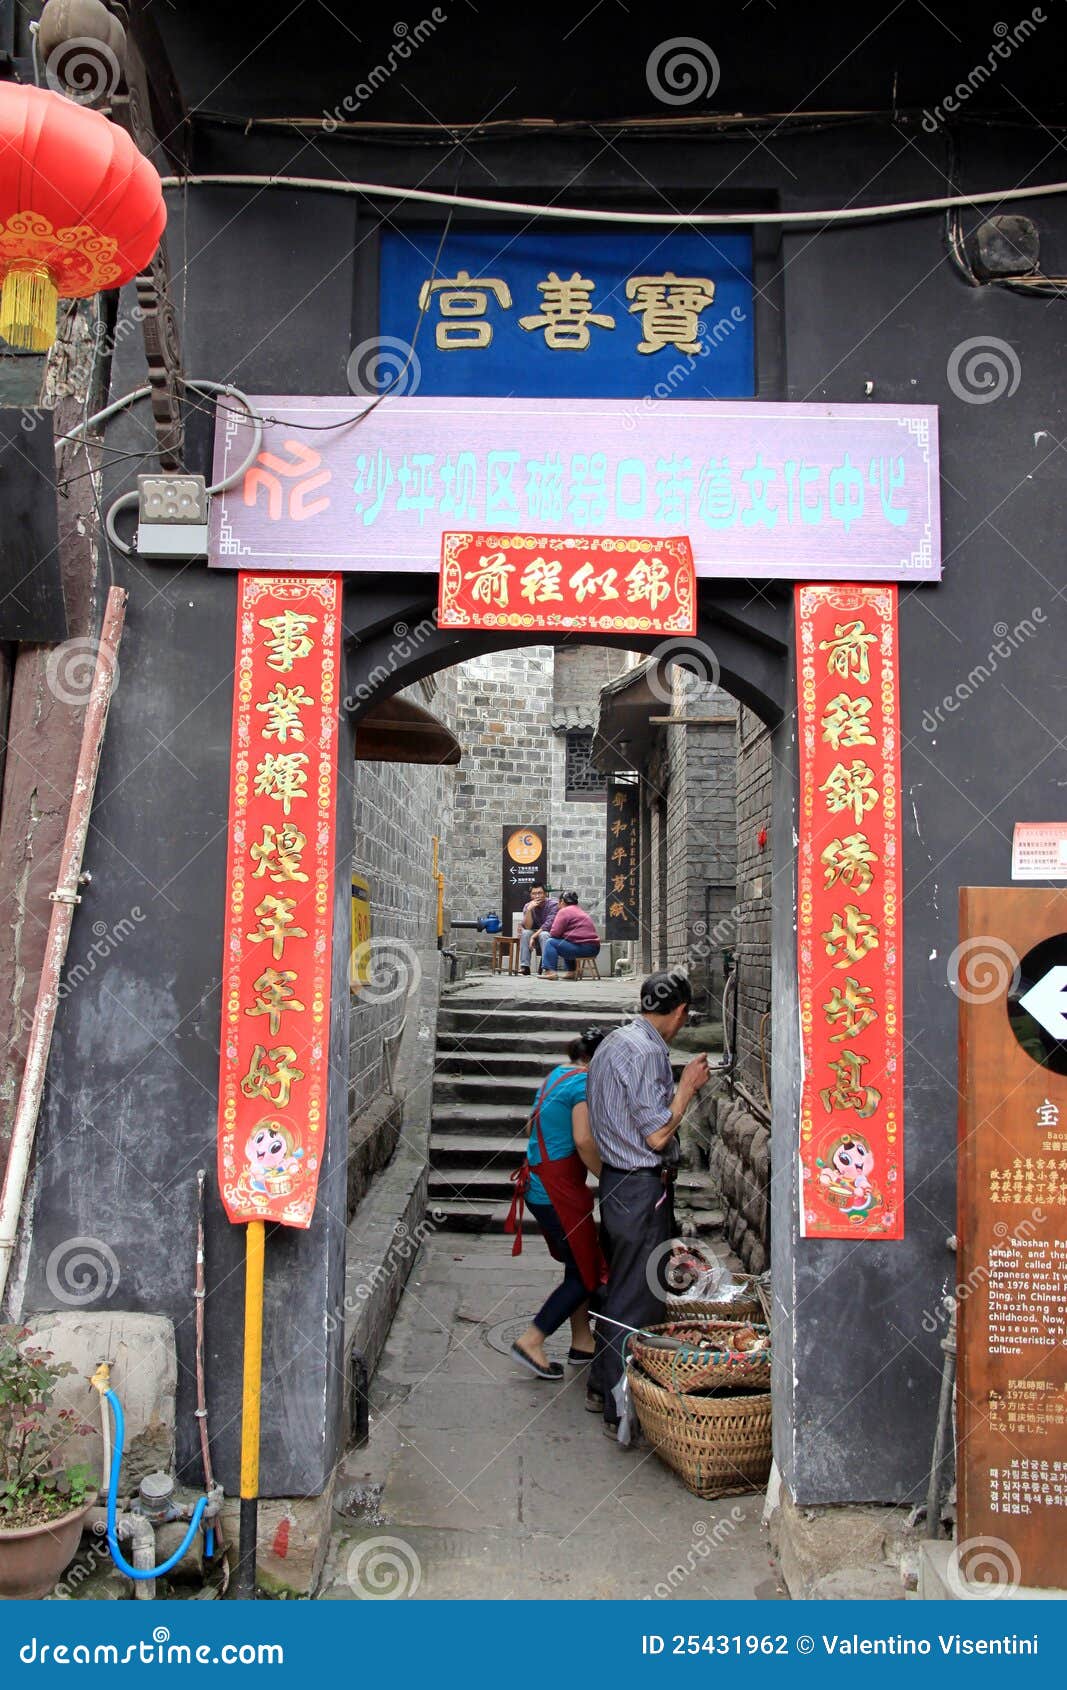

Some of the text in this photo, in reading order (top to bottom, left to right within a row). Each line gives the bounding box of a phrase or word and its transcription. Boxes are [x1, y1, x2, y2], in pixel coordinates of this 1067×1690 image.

[353, 448, 909, 534] 沙坪坝区磁器口街道文化中心
[1036, 1098, 1059, 1126] 宝
[1011, 1239, 1049, 1248] Baoshan
[1028, 1250, 1045, 1258] and
[989, 1260, 1018, 1268] school
[1025, 1261, 1052, 1269] called
[988, 1270, 1030, 1280] Japanese
[1053, 1272, 1060, 1280] It
[989, 1281, 1004, 1289] the
[1007, 1281, 1029, 1289] 1976
[1032, 1282, 1060, 1291] Nobel
[1018, 1292, 1026, 1300] in
[1031, 1292, 1067, 1302] Chinese
[989, 1302, 1049, 1314] Zhaozhong
[989, 1313, 1065, 1324] childhood. Now,
[989, 1324, 1039, 1333] museum
[989, 1335, 1055, 1345] characteristics
[989, 1346, 1023, 1354] culture.
[990, 1503, 999, 1513] 이
